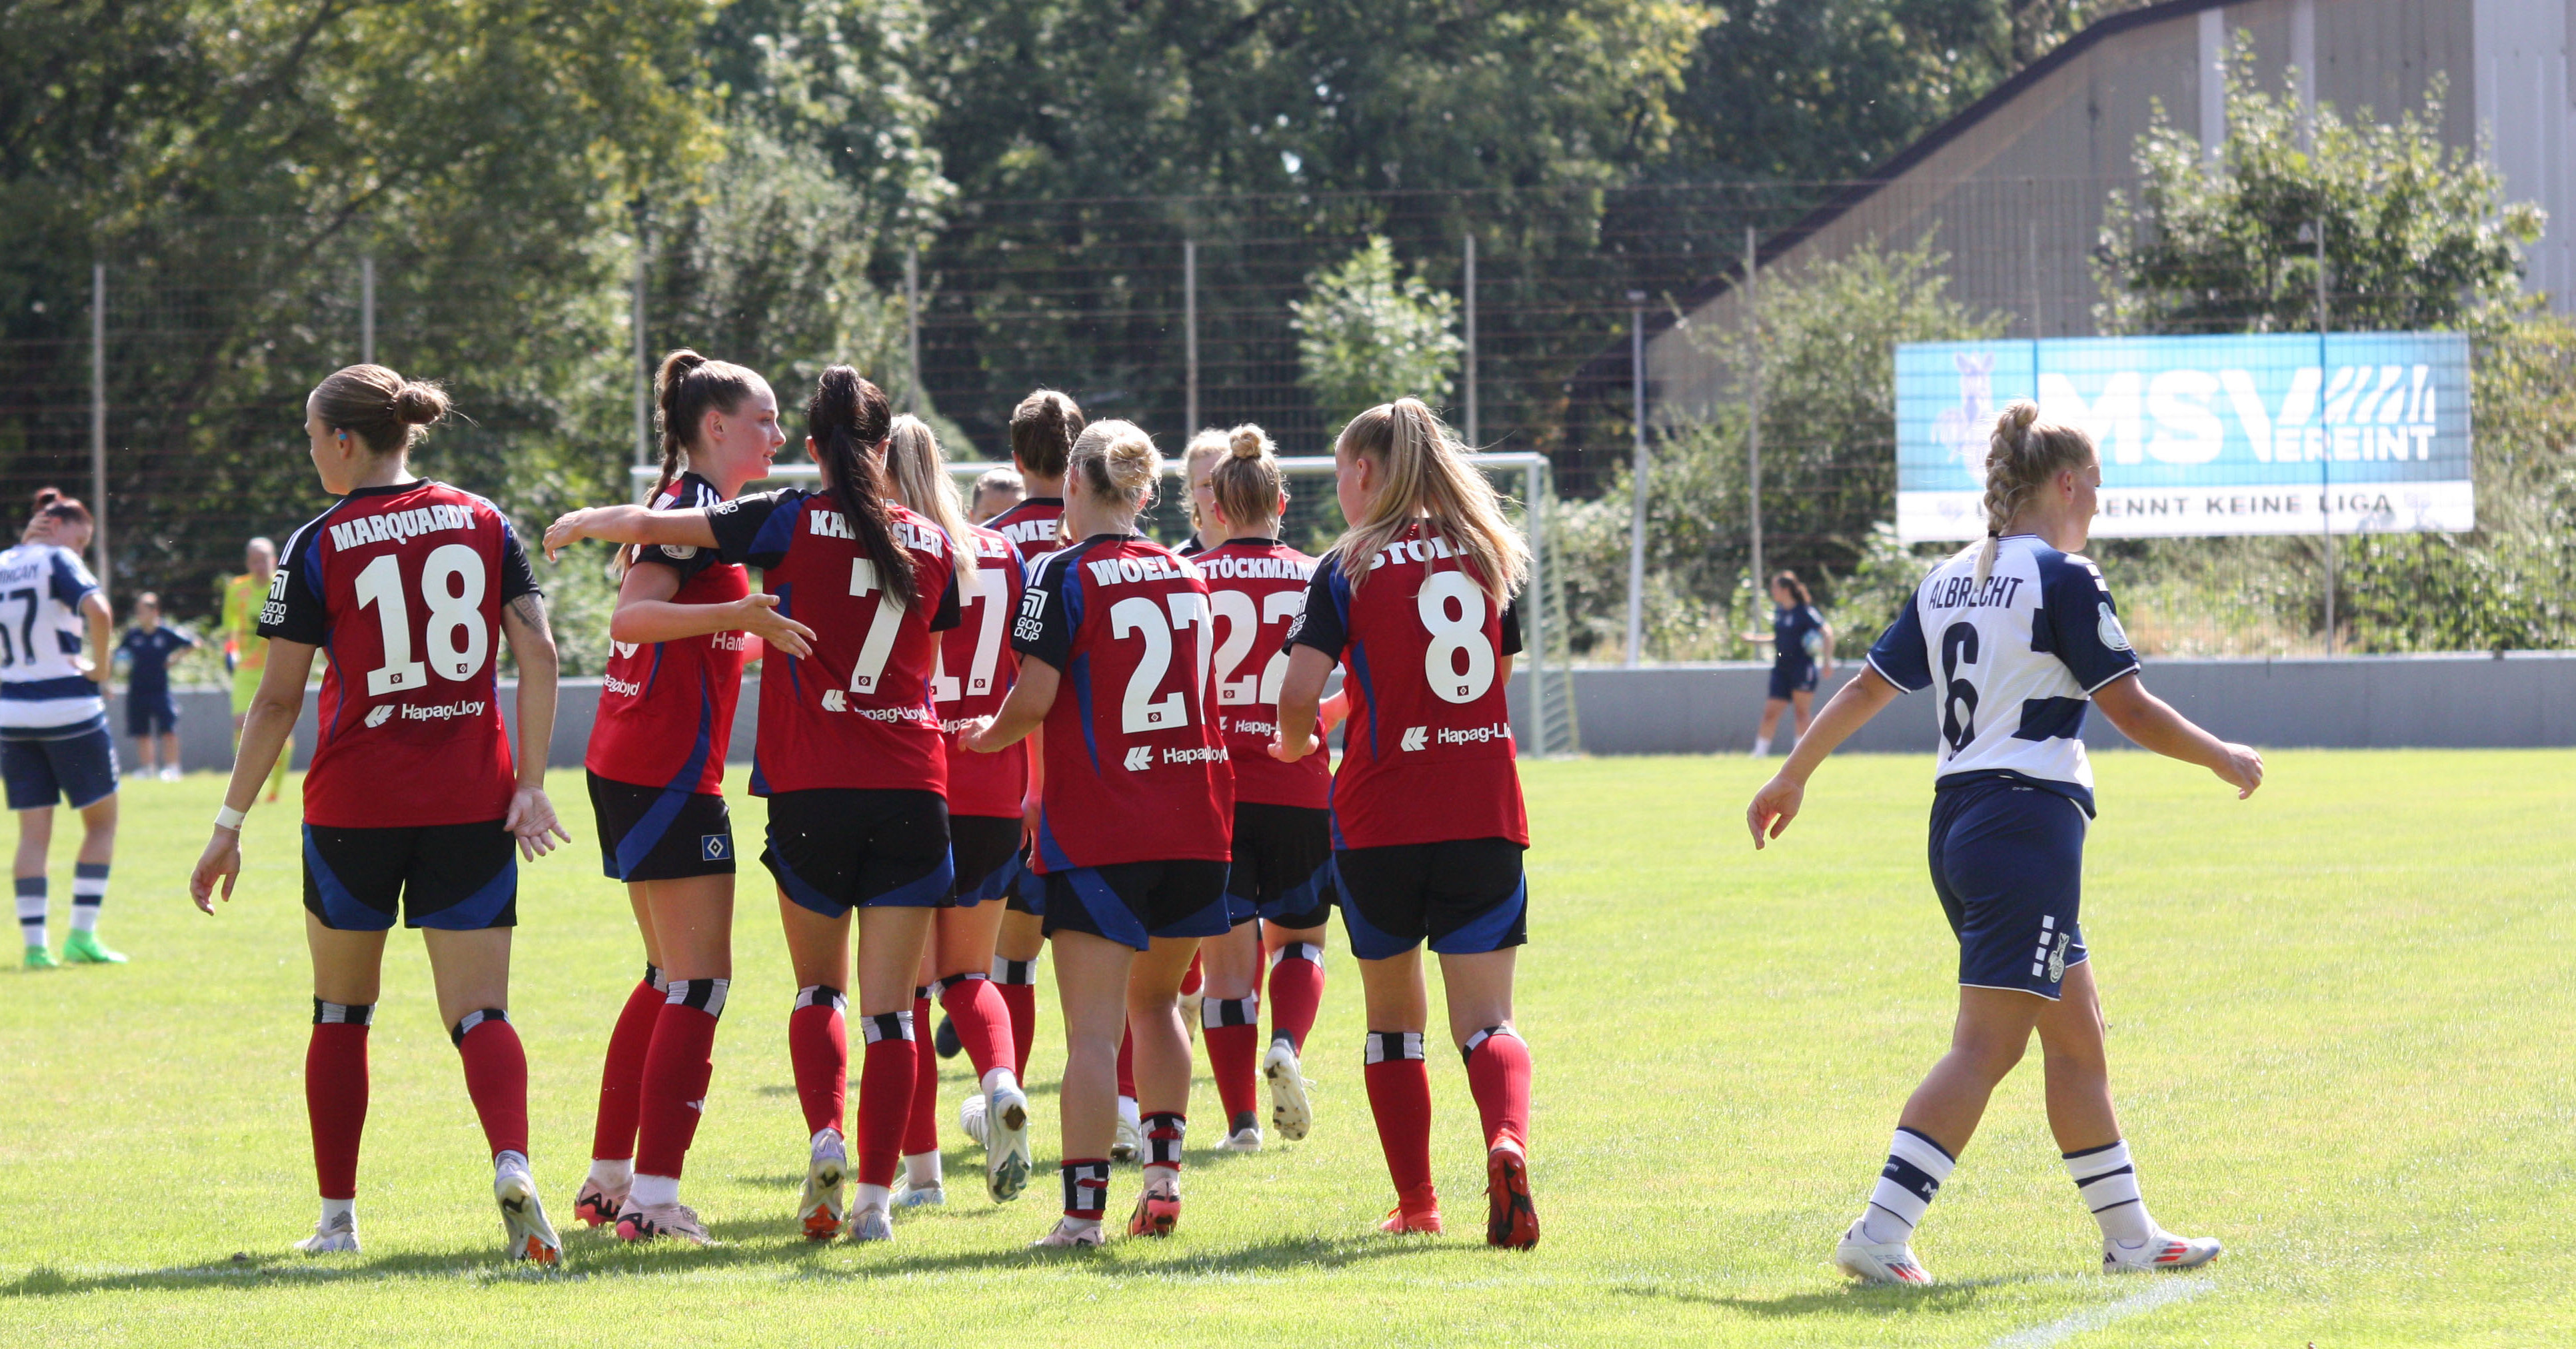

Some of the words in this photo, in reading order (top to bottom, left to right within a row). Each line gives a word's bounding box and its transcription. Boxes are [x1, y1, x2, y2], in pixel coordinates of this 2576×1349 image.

[329, 505, 477, 553] MARQUARDT
[2105, 497, 2190, 517] ENNT
[2206, 495, 2301, 514] KEINE
[2319, 493, 2393, 514] LIGA
[1928, 575, 2024, 611] ALBRECHT
[354, 543, 488, 697] 18
[849, 557, 914, 694] 7
[1013, 627, 1040, 642] OUP
[1016, 616, 1044, 633] GOO
[1418, 571, 1495, 704] 8
[1110, 591, 1214, 734] 27
[1209, 589, 1304, 706] 22
[401, 700, 485, 722] Hapag-Lloy
[1941, 621, 1979, 762] 6
[1437, 722, 1512, 746] Hapag-Llo
